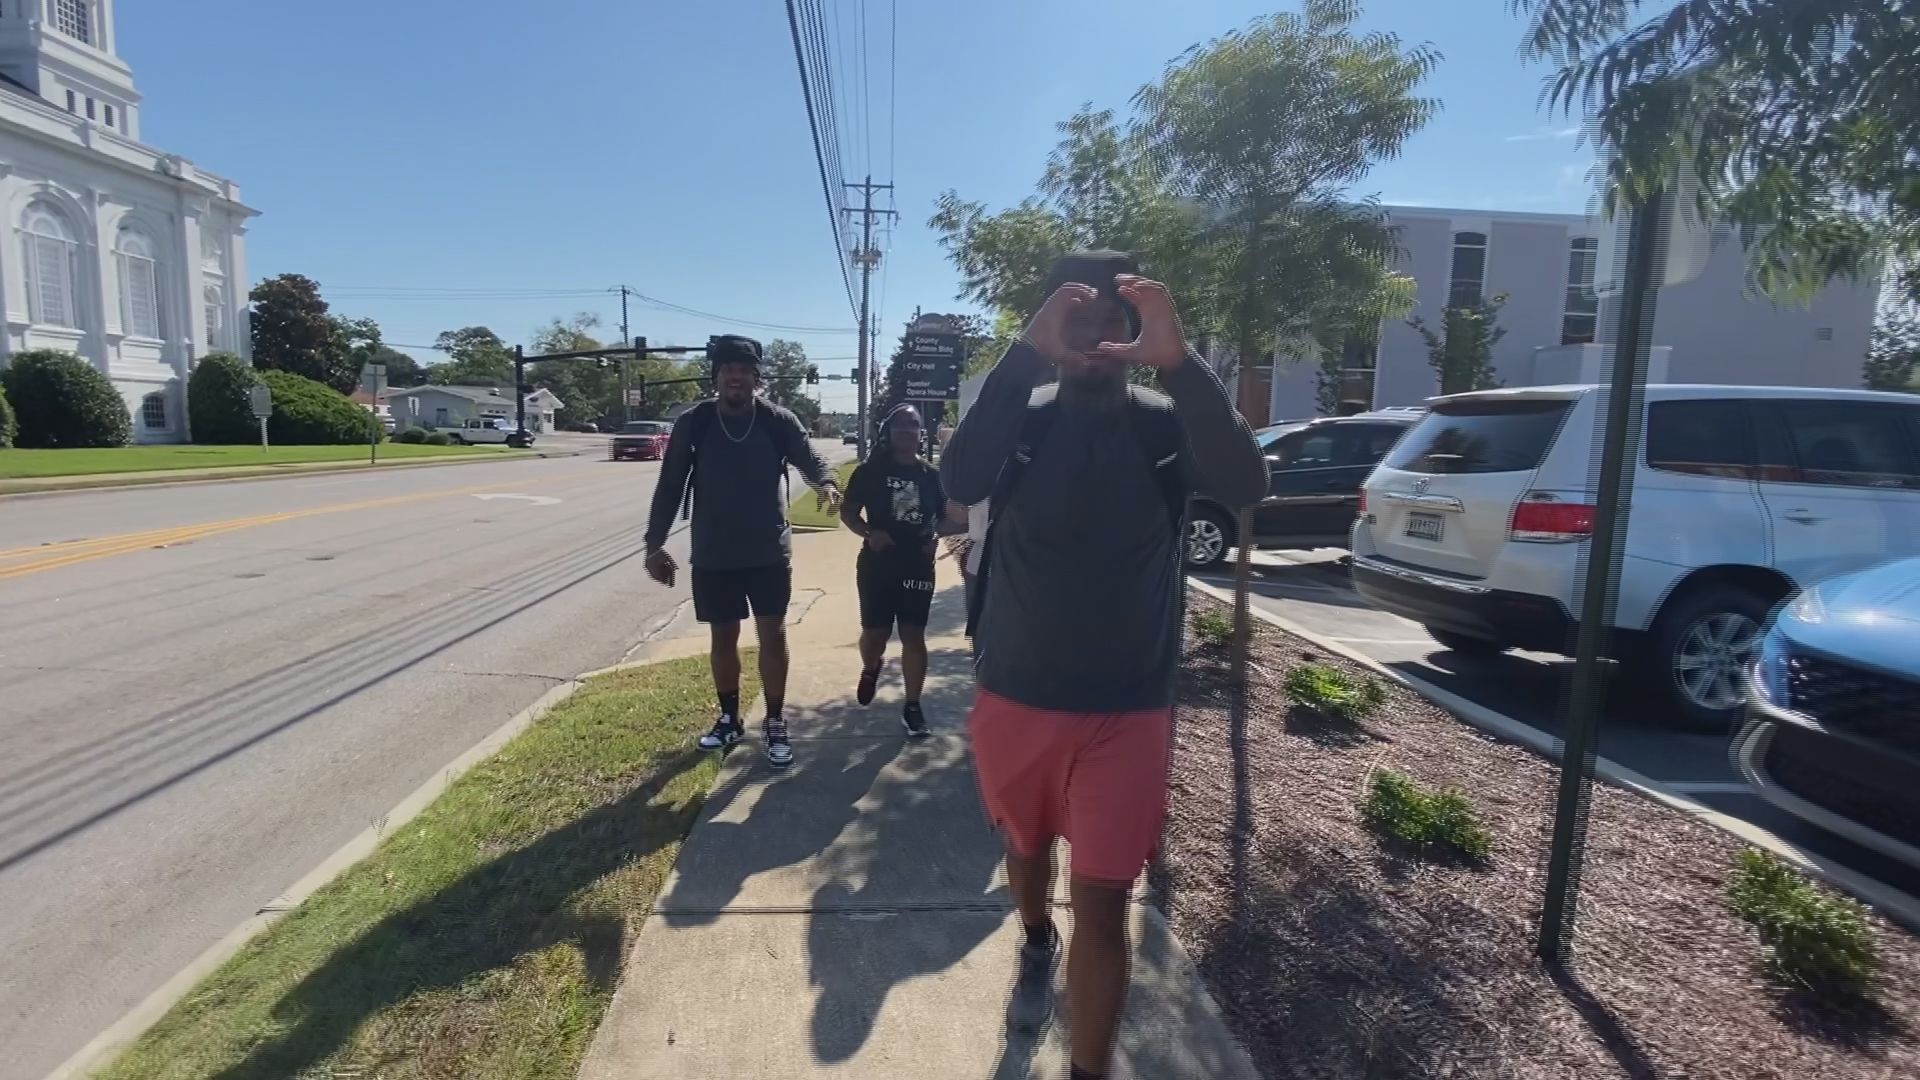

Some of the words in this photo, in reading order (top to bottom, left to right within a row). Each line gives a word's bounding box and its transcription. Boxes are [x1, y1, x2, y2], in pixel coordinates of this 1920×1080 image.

[915, 337, 939, 345] County
[906, 362, 921, 371] City
[906, 388, 926, 396] Opera
